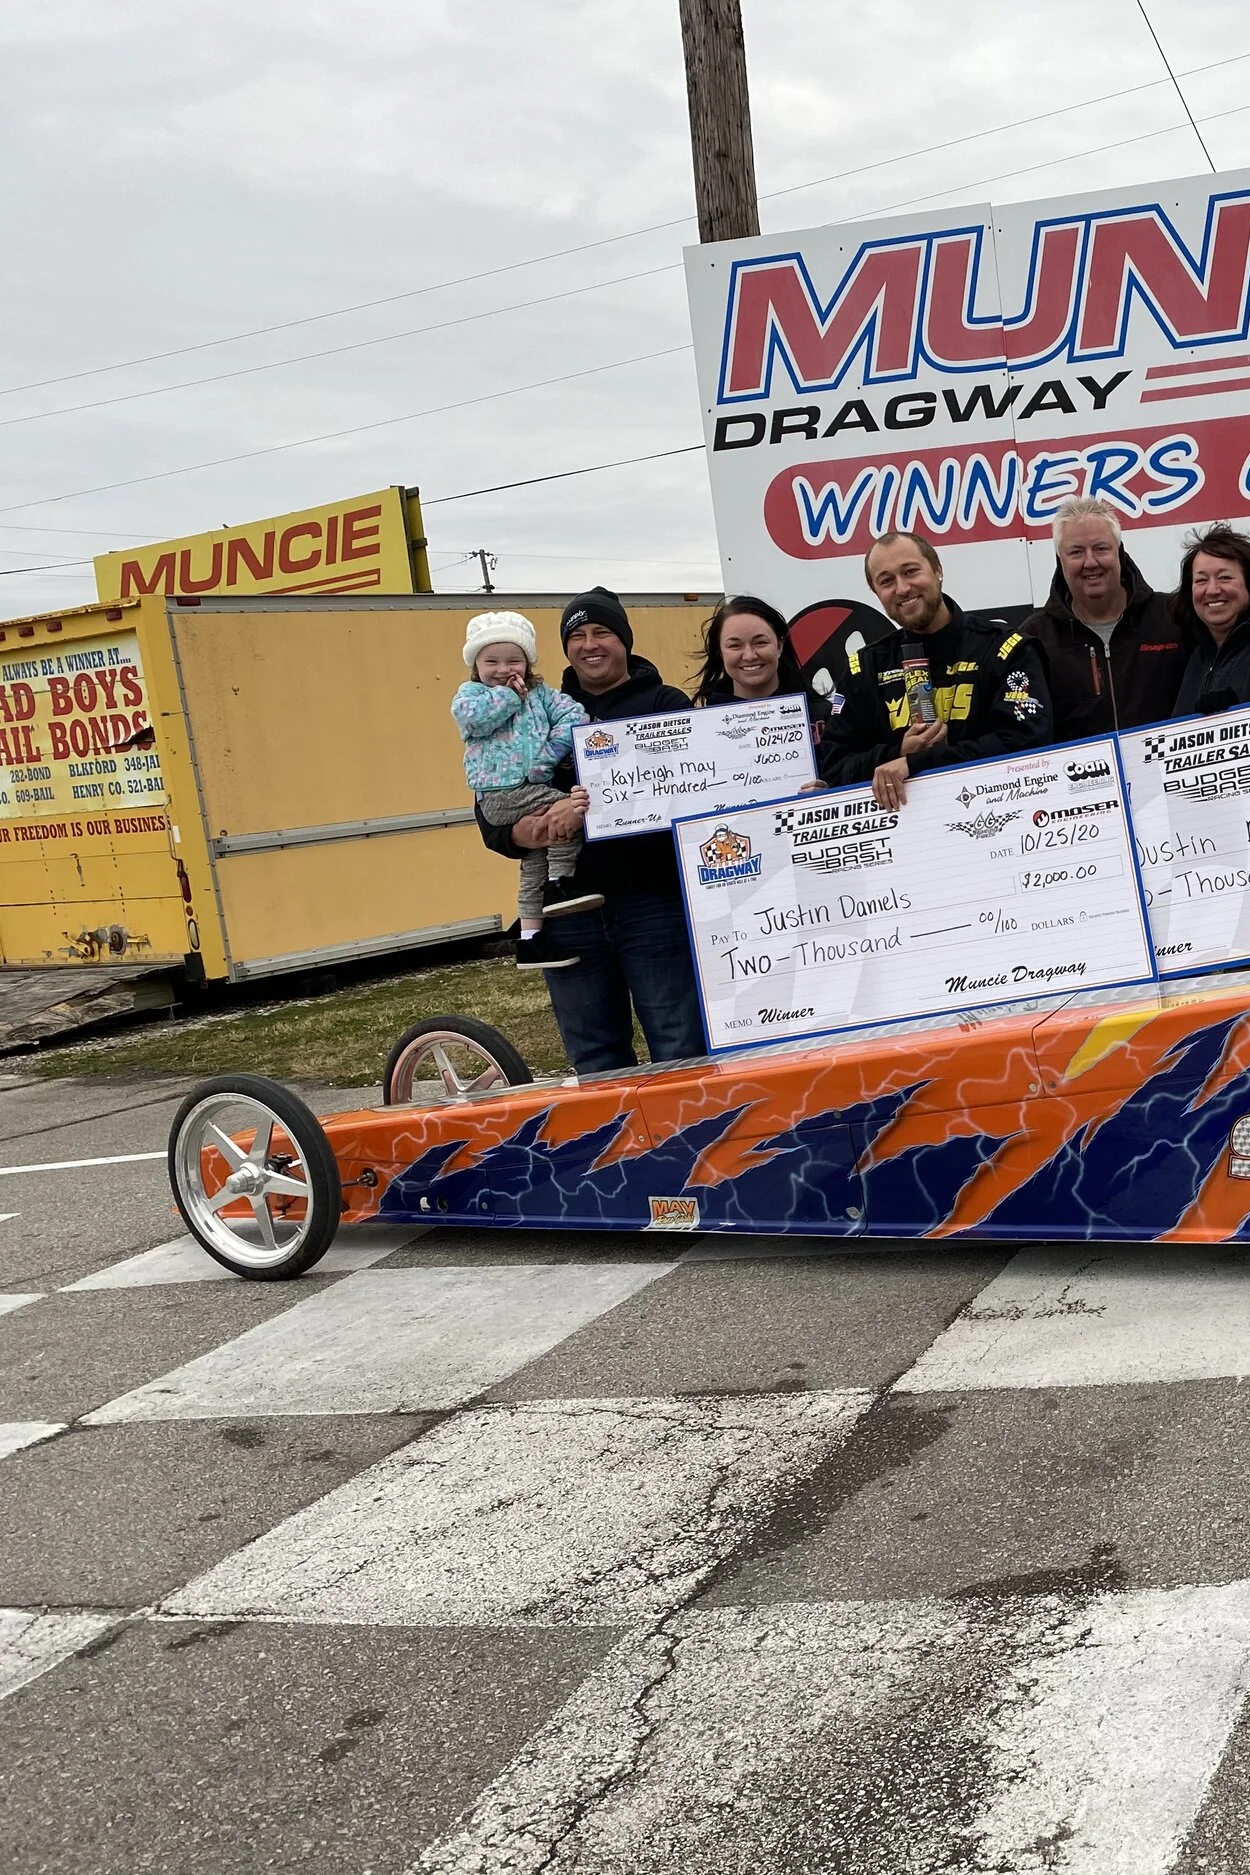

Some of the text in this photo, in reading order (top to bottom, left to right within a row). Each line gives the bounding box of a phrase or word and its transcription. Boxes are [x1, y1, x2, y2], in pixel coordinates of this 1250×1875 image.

[713, 369, 1133, 452] DRAGWAY
[791, 433, 1203, 547] WINNERS
[119, 504, 382, 599] MUNCIE
[997, 633, 1023, 660] JEGS
[2, 661, 39, 682] ALWAYS
[40, 658, 54, 676] BE
[57, 657, 64, 674] A
[65, 650, 106, 672] WINNER
[905, 669, 929, 680] FLEX
[47, 665, 143, 717] BOYS
[905, 676, 929, 691] SEAL
[885, 683, 974, 731] JGS
[48, 710, 153, 761] BONDS
[635, 726, 692, 741] TRAILER SALES
[638, 718, 691, 731] JASON DIETSCH
[635, 737, 688, 750] BUDGET
[755, 730, 803, 748] 10/24/20
[1169, 731, 1215, 752] JASON
[585, 745, 618, 757] DRAGWAY
[1163, 748, 1225, 772] TRAILER
[10, 766, 51, 783] 282-BOND
[69, 759, 117, 778] BLKFORD
[611, 766, 674, 788] Kayleigh
[1006, 758, 1050, 775] Presented by
[1063, 758, 1111, 782] Coan
[15, 787, 55, 803] 609-BAIL
[72, 783, 104, 799] HENRY
[108, 782, 125, 795] CO.
[976, 772, 1058, 796] Diamond Engine
[985, 787, 1048, 805] and Machine
[1208, 790, 1240, 802] RACING
[614, 814, 662, 828] Runner-Up
[798, 800, 886, 826] JASON DIETS
[1051, 810, 1112, 824] ENGINEERING
[14, 824, 68, 841] FREEDOM
[71, 822, 83, 837] IS
[87, 820, 111, 836] OUR
[792, 815, 899, 846] TRAILER SALES
[1020, 823, 1100, 855] 10/25/20
[792, 836, 891, 865] BUDGET
[825, 848, 892, 875] BASH
[990, 848, 1014, 860] DATE
[700, 857, 759, 882] DRAGWAY
[831, 858, 894, 874] RACING SERIES
[1022, 864, 1097, 889] $2,000.00
[754, 888, 911, 935] Justin Daniels
[1031, 916, 1075, 932] DOLLARS
[945, 959, 1087, 993] Muncie Dragway
[725, 1018, 753, 1030] MEMO
[758, 1006, 815, 1024] Winner
[652, 1200, 696, 1221] MAY
